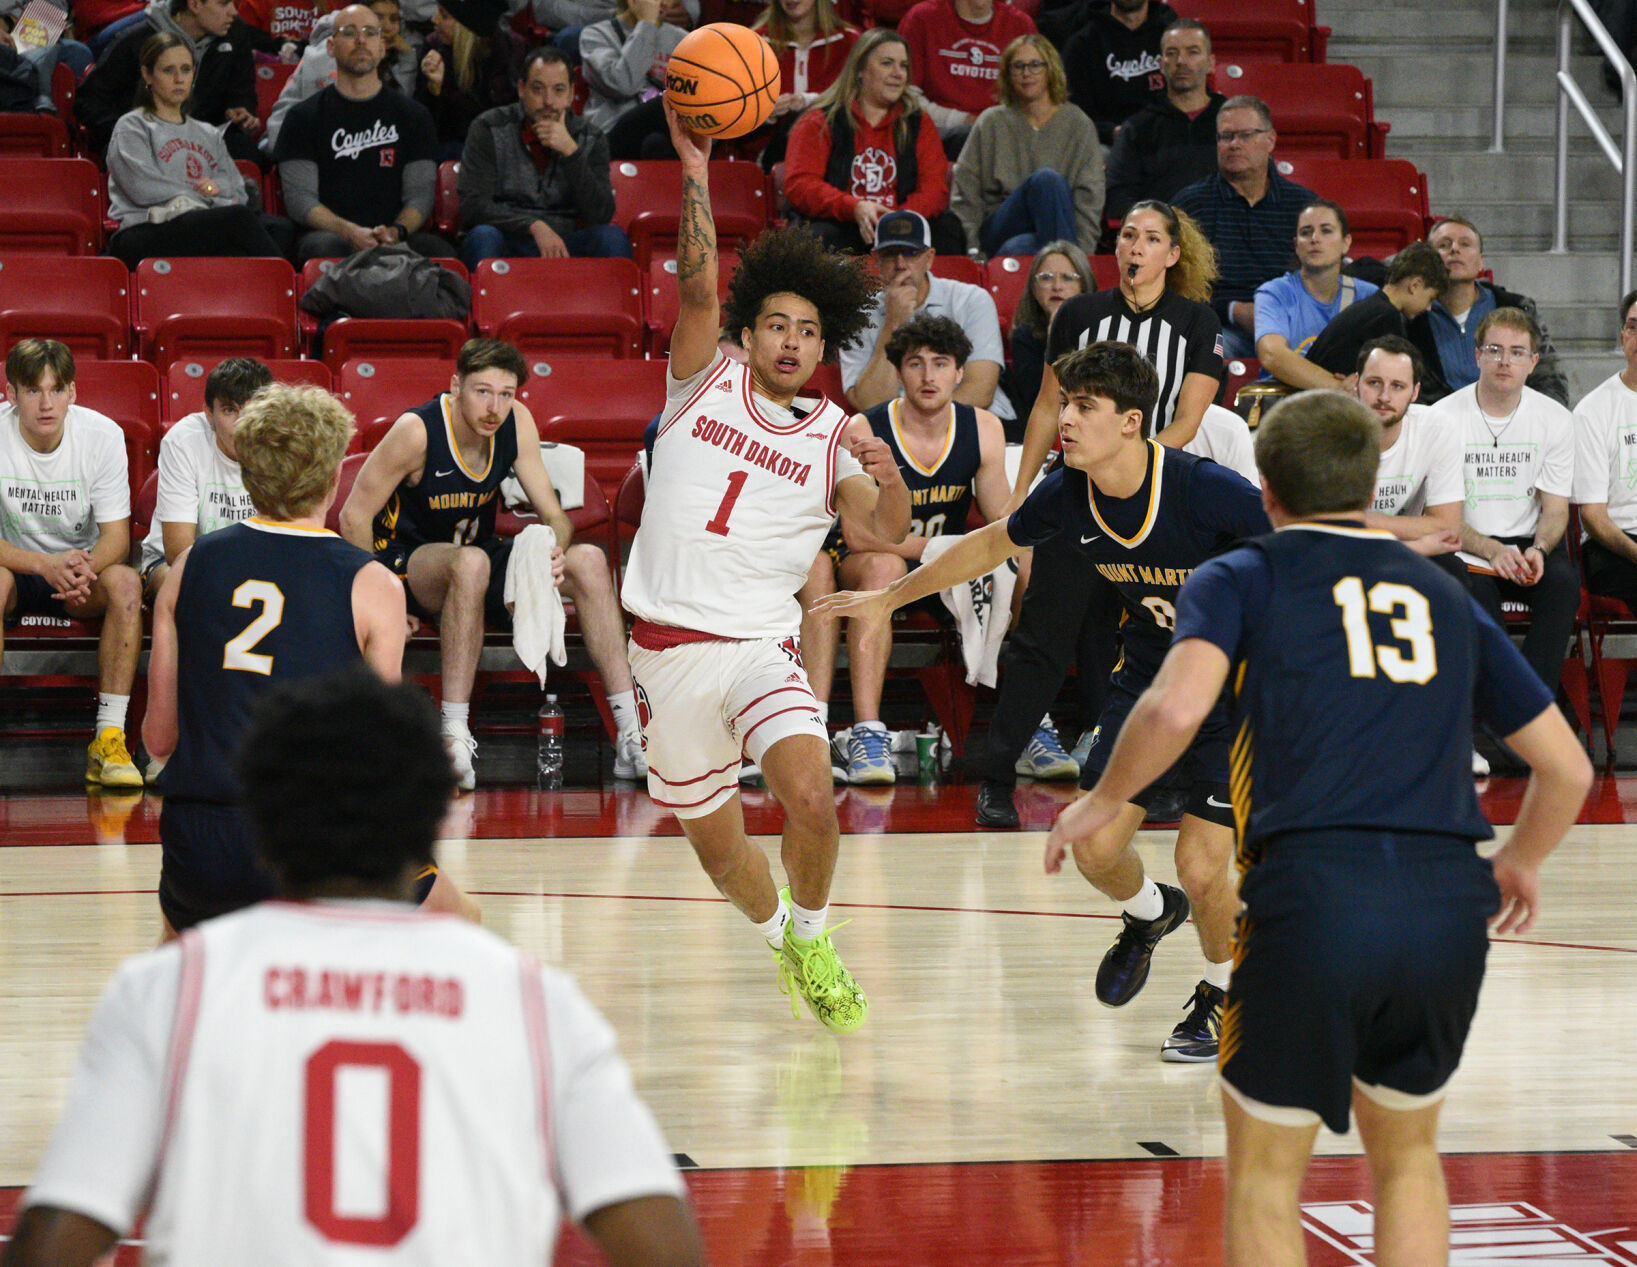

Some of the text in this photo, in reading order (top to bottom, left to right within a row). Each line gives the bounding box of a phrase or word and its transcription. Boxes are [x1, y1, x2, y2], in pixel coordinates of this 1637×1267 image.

[331, 119, 399, 160] Coyotes
[691, 414, 812, 487] SOUTH DAKOTA
[1464, 452, 1531, 464] MENTAL HEALTH
[1476, 466, 1517, 478] MATTERS
[7, 486, 77, 502] MENTAL HEALTH
[21, 502, 62, 516] MATTERS
[428, 491, 478, 510] MOUNT
[704, 470, 749, 537] 1
[21, 615, 72, 628] COYOTES
[222, 578, 286, 677] 2
[1332, 575, 1438, 686] 13
[263, 964, 465, 1021] CRAWFORD
[303, 1038, 421, 1247] 0
